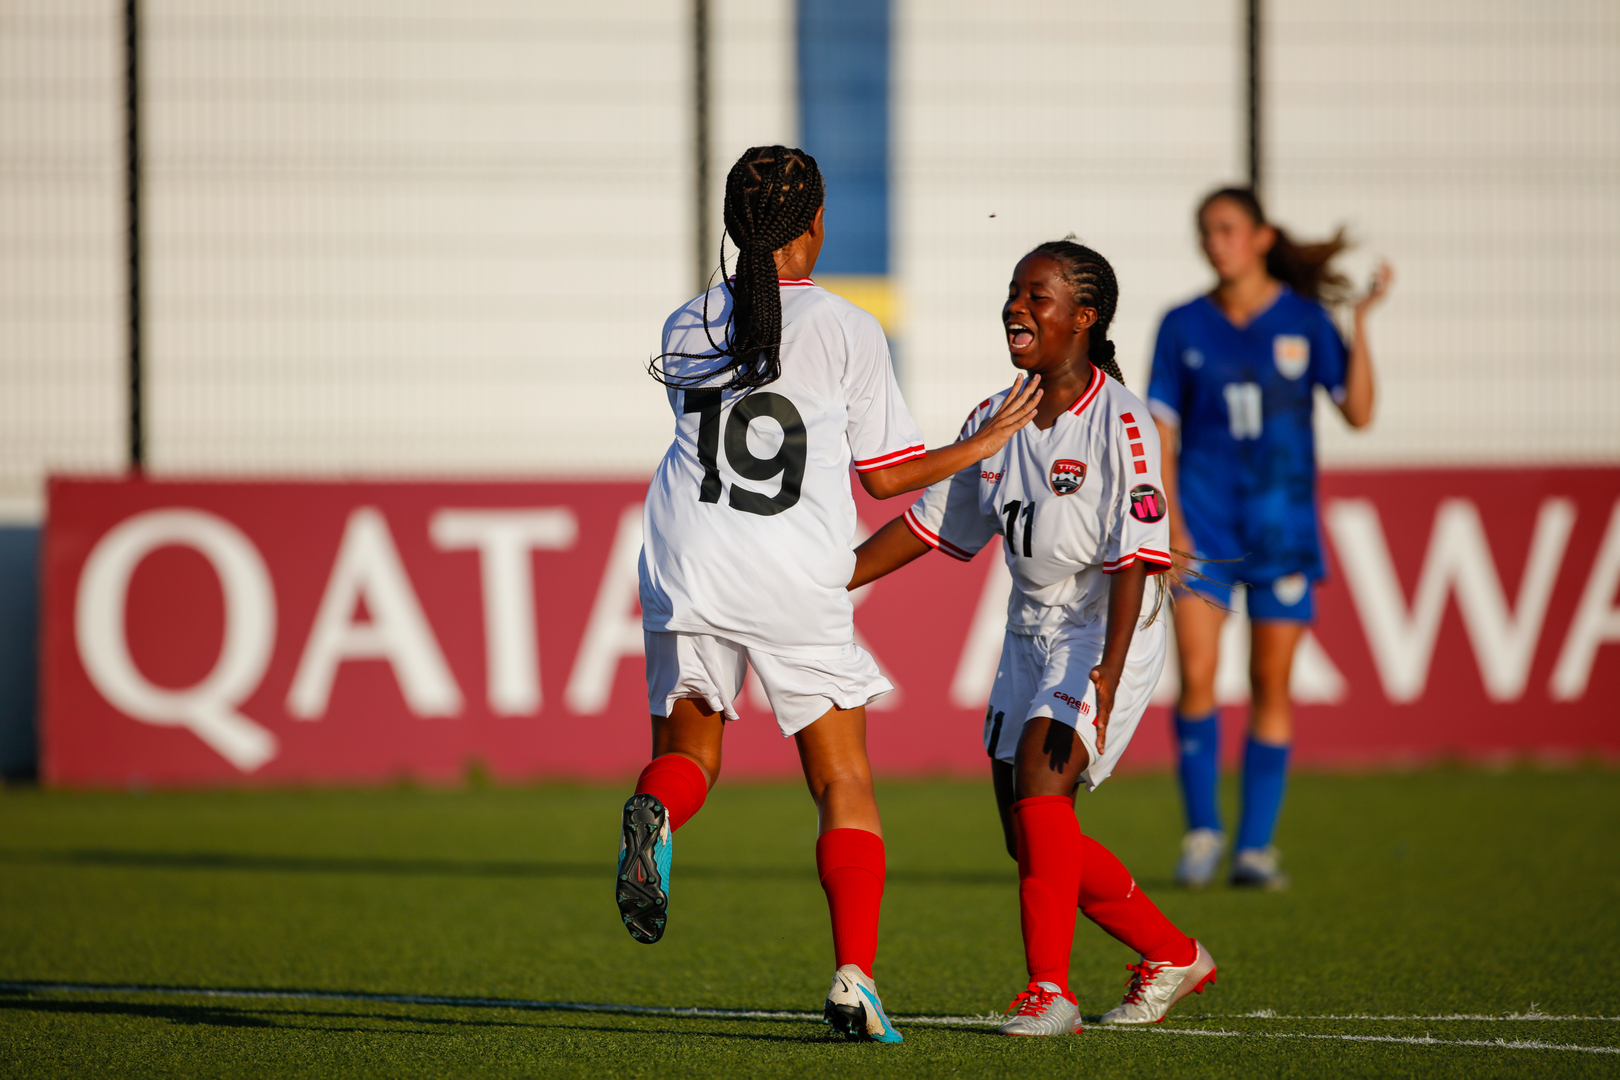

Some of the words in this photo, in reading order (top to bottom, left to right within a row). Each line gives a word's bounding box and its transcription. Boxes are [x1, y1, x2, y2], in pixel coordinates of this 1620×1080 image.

[1223, 382, 1263, 441] 11
[683, 389, 808, 517] 19
[1058, 463, 1081, 473] TTFA
[1002, 499, 1036, 558] 11
[75, 505, 903, 773] QATA
[1053, 691, 1091, 715] capelli
